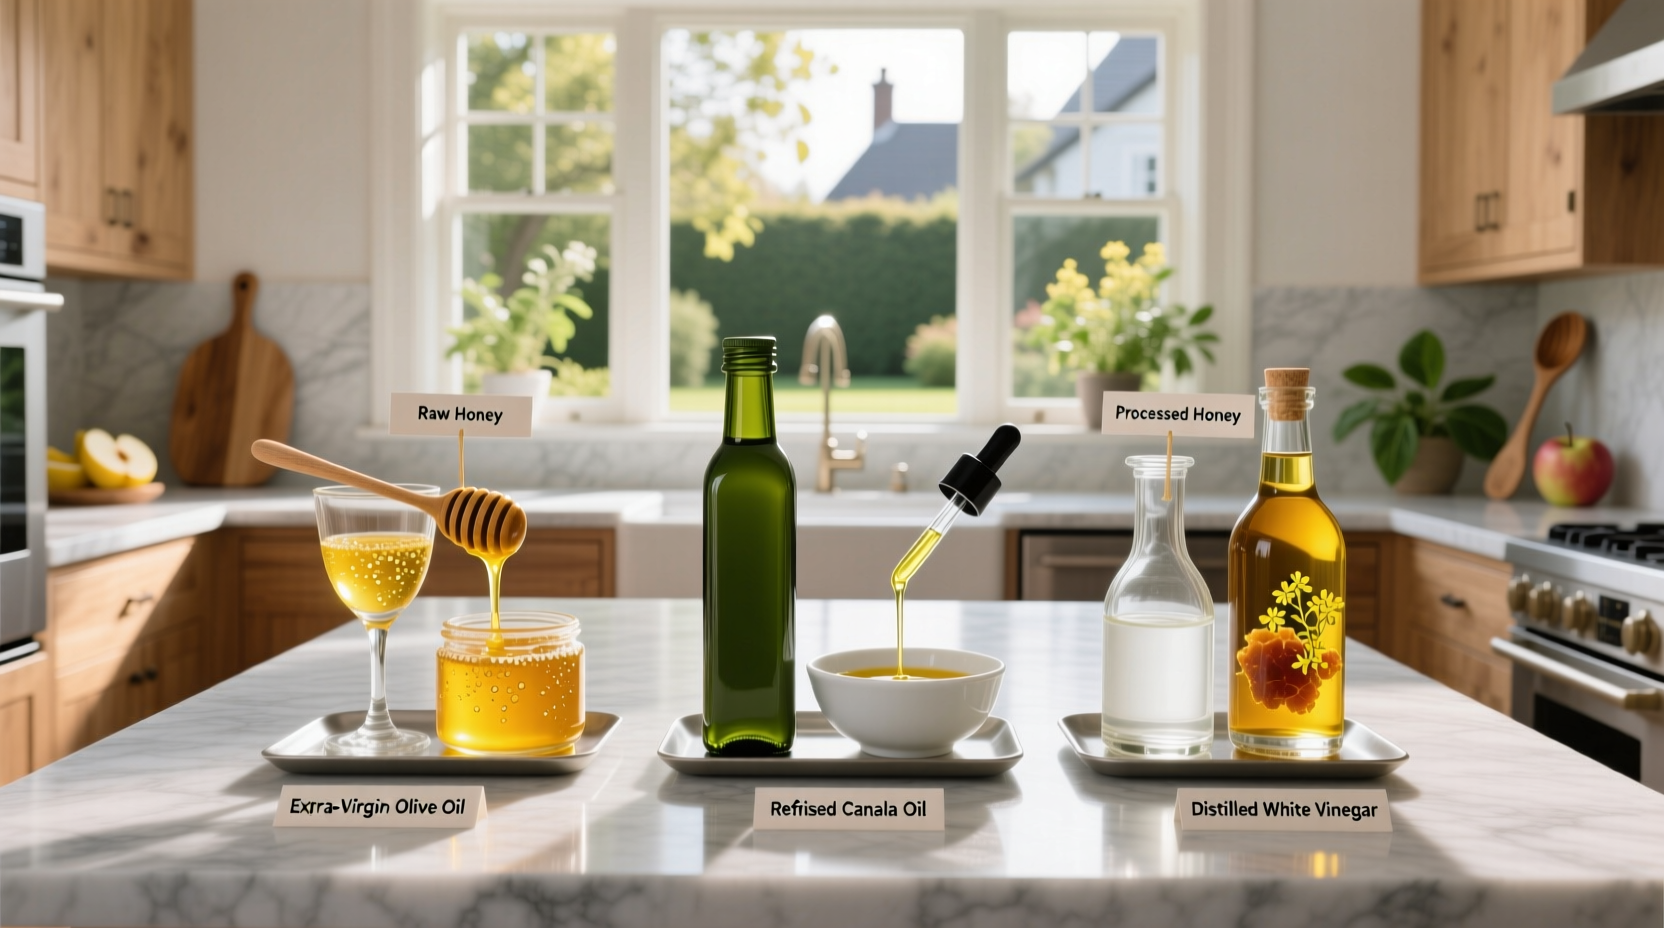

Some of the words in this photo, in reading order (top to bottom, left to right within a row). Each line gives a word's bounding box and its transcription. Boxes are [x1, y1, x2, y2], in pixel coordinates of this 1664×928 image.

[417, 405, 450, 420] Raw
[454, 406, 503, 425] Honey
[1115, 404, 1188, 420] Processed
[1193, 406, 1241, 425] Honey
[395, 797, 438, 814] Olive
[441, 797, 466, 814] Oil
[841, 799, 897, 816] Canala
[902, 799, 927, 816] Oil
[1191, 799, 1258, 816] Distilled
[1262, 800, 1310, 817] White
[1314, 801, 1379, 821] Vinegar
